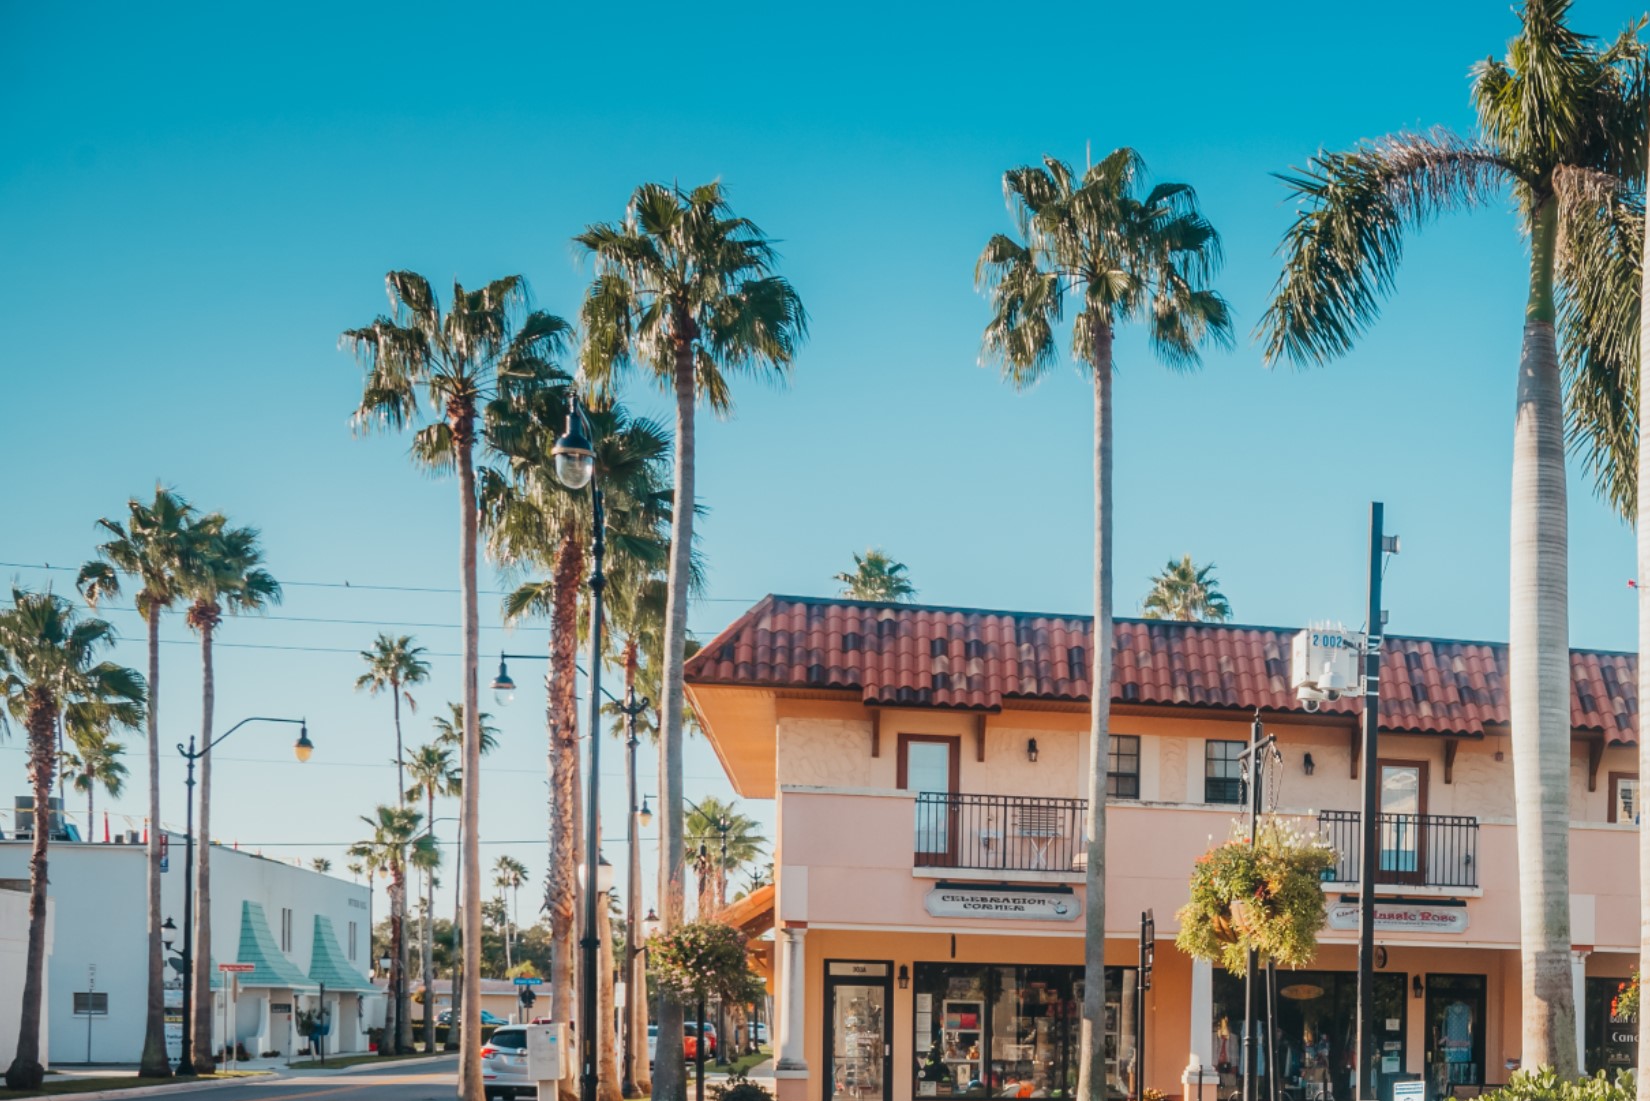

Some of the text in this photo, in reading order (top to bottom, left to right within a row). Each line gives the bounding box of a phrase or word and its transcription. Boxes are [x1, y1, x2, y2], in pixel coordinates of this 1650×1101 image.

[941, 895, 1046, 906] CELEBRATION
[963, 903, 1025, 912] CORNER
[1373, 910, 1416, 921] lassic
[1420, 911, 1457, 922] Rose
